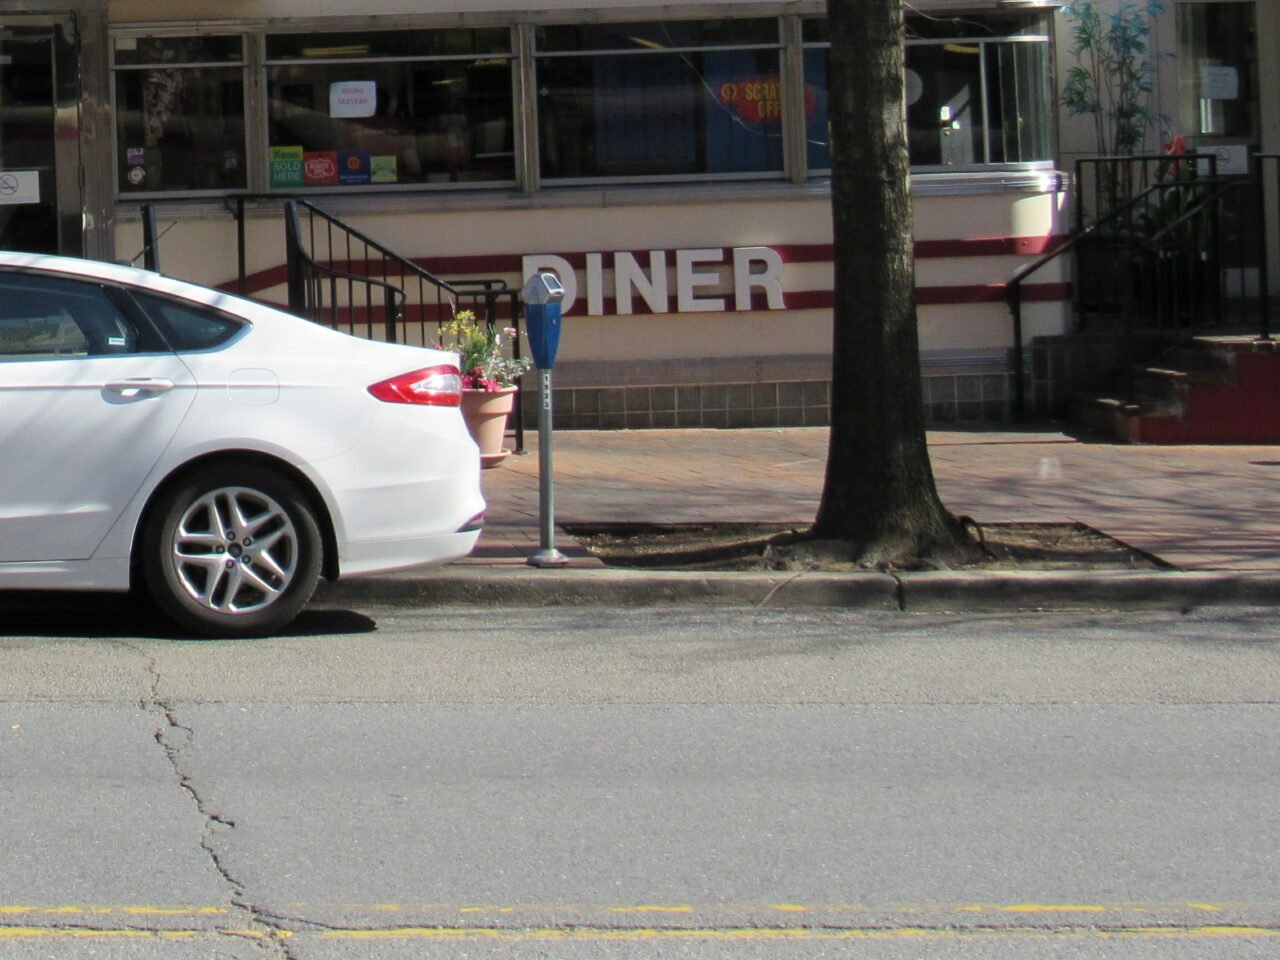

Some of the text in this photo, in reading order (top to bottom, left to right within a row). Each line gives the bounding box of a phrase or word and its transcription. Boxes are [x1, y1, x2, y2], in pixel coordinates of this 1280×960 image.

[745, 83, 781, 100] SCRA
[272, 161, 300, 171] SOLD
[273, 172, 300, 181] HERE
[522, 246, 787, 317] DINER
